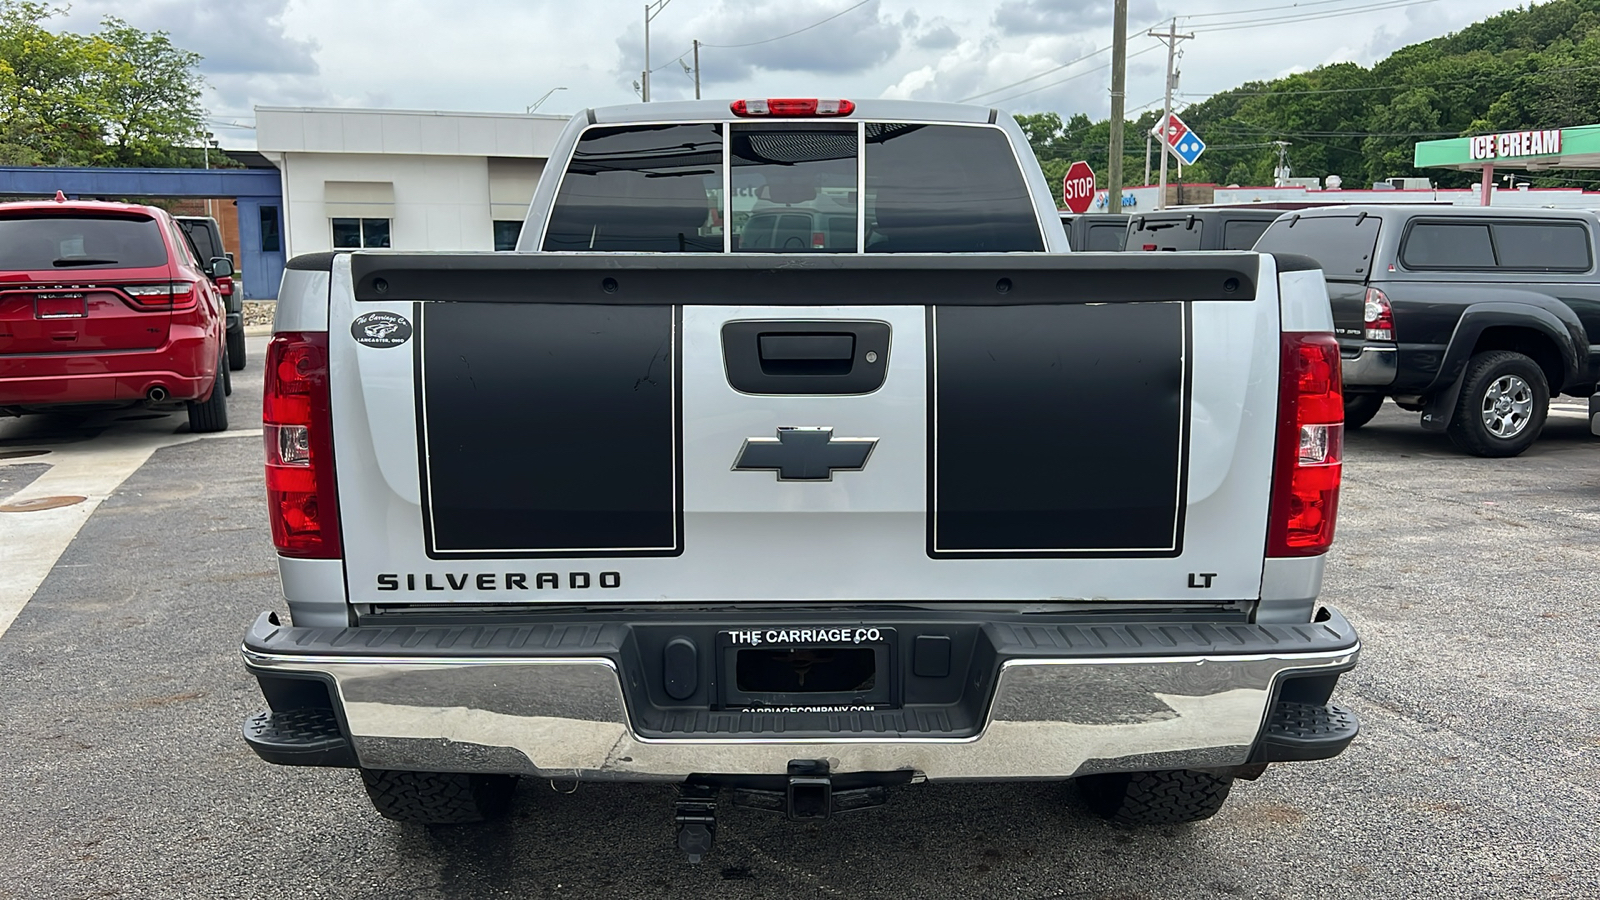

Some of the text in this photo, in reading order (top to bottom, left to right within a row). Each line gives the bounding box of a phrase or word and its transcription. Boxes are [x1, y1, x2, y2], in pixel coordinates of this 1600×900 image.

[1469, 129, 1562, 160] ICE CREAM
[1066, 177, 1093, 199] STOP
[368, 313, 397, 322] Carriage
[377, 571, 621, 591] SILVERADO
[1187, 572, 1218, 589] LT
[728, 628, 884, 644] THE CARRIAGE CO.
